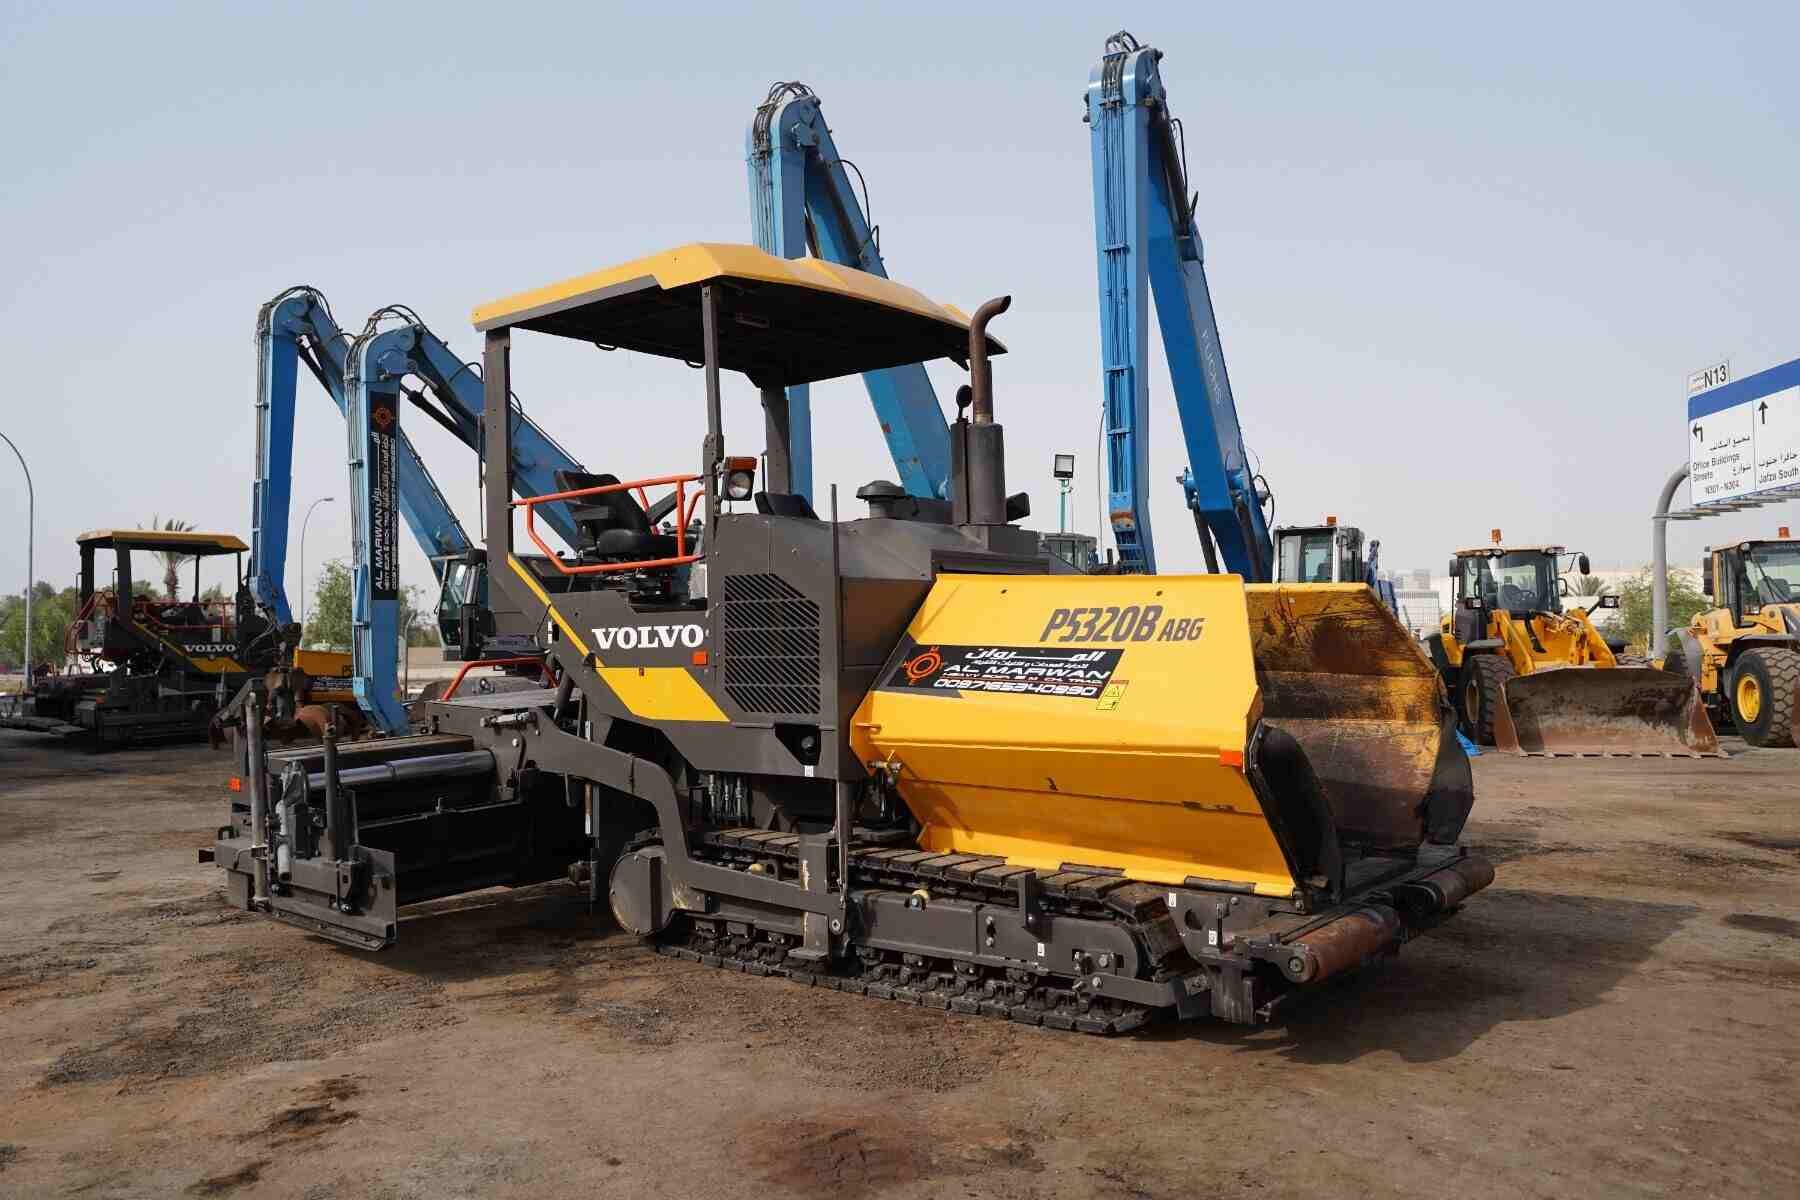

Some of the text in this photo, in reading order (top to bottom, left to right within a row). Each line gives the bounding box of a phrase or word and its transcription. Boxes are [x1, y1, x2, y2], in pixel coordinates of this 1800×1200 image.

[1704, 364, 1727, 389] N13
[1778, 465, 1799, 480] South
[375, 506, 384, 590] AL MARWAN
[1039, 605, 1206, 642] P5320B ABG
[184, 643, 237, 653] VOLVO
[592, 624, 704, 649] VOLVO
[944, 664, 980, 673] AL
[985, 666, 1112, 679] MARWAN
